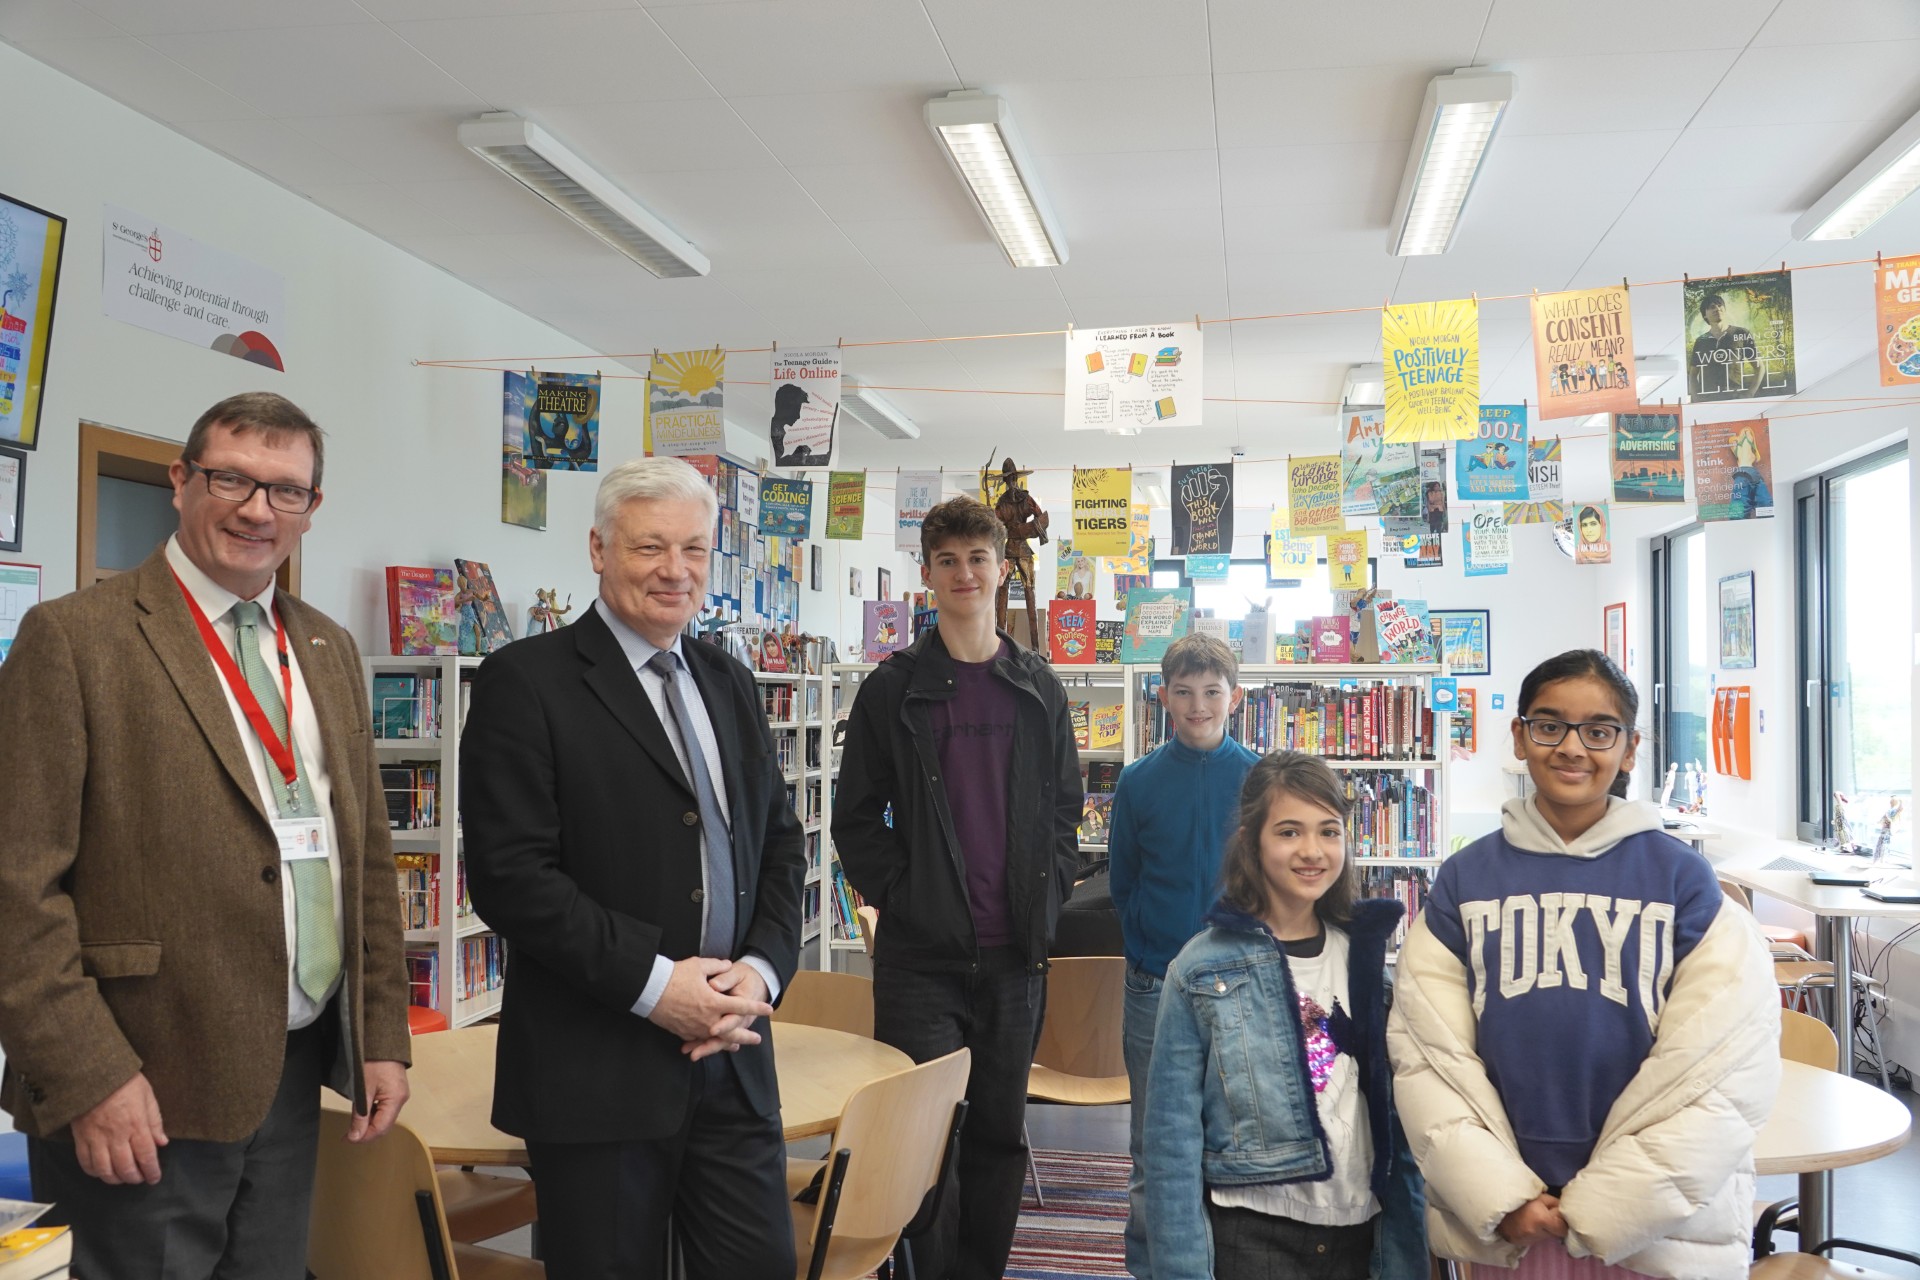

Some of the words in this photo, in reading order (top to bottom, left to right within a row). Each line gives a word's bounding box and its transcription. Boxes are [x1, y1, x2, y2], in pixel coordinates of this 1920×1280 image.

[128, 262, 184, 295] Achieving
[184, 284, 230, 310] potential
[232, 300, 269, 324] through
[128, 283, 181, 312] challenge
[183, 303, 205, 320] and
[206, 312, 230, 329] care.
[1543, 298, 1581, 319] WHAT
[1588, 293, 1622, 314] DOES
[1546, 311, 1622, 343] CONSENT
[1129, 332, 1148, 340] FROM
[1158, 331, 1175, 339] BOOK
[1409, 336, 1430, 346] NICOLA
[1433, 333, 1460, 344] MORGAN
[1733, 333, 1761, 342] BRIAN
[1764, 330, 1783, 339] COX
[1548, 342, 1585, 363] REALLY
[1590, 337, 1625, 358] MEAN?
[1696, 344, 1786, 364] WONDERS
[1393, 347, 1469, 371] POSITIVELY
[774, 368, 796, 380] Life
[799, 367, 838, 379] Online
[1398, 366, 1464, 391] TEENAGE
[1696, 358, 1787, 395] LIFE
[538, 389, 587, 398] MAKING
[1409, 388, 1438, 400] POSITIVELY
[538, 396, 586, 413] THEATRE
[1408, 400, 1423, 408] GUIDE
[1431, 397, 1456, 405] TEENAGE
[1416, 405, 1451, 415] WELL-BEING
[1478, 409, 1511, 418] KEEP
[656, 413, 720, 429] PRACTICAL
[1362, 415, 1374, 423] THE
[657, 426, 721, 439] MINDFULNESS
[1347, 416, 1385, 444] Art
[1478, 421, 1524, 443] OOL
[1620, 440, 1676, 451] ADVERTISING
[1696, 457, 1724, 467] think
[1291, 461, 1333, 481] Right
[1528, 465, 1559, 483] NISH
[772, 483, 788, 491] GET
[1697, 476, 1711, 485] be
[1698, 483, 1743, 493] confident
[762, 490, 809, 505] CODING!
[831, 493, 862, 505] SCIENCE
[1698, 493, 1711, 501] for
[1714, 491, 1742, 500] teens
[1074, 498, 1127, 509] FIGHTING
[1187, 497, 1208, 511] THIS
[900, 509, 927, 519] brillia
[1191, 501, 1220, 522] BOOK
[899, 520, 922, 528] teena
[1075, 517, 1127, 530] TIGERS
[1198, 514, 1216, 525] WILL
[1474, 513, 1507, 529] OPE
[1192, 529, 1217, 541] CHANGE
[1275, 529, 1290, 540] EST
[1190, 543, 1218, 553] WORLD
[1282, 540, 1313, 555] Being
[1589, 543, 1608, 552] MALALA
[1280, 552, 1306, 565] YOU
[1058, 615, 1086, 628] TEEN
[1379, 607, 1407, 623] CHANGE
[1384, 618, 1420, 641] WORLD
[1055, 631, 1088, 645] Pioneers
[1363, 717, 1370, 728] ME
[1402, 702, 1410, 744] encyclopedia
[1098, 729, 1116, 738] YOU
[1363, 729, 1370, 740] UP
[1459, 892, 1675, 1037] TOKYO
